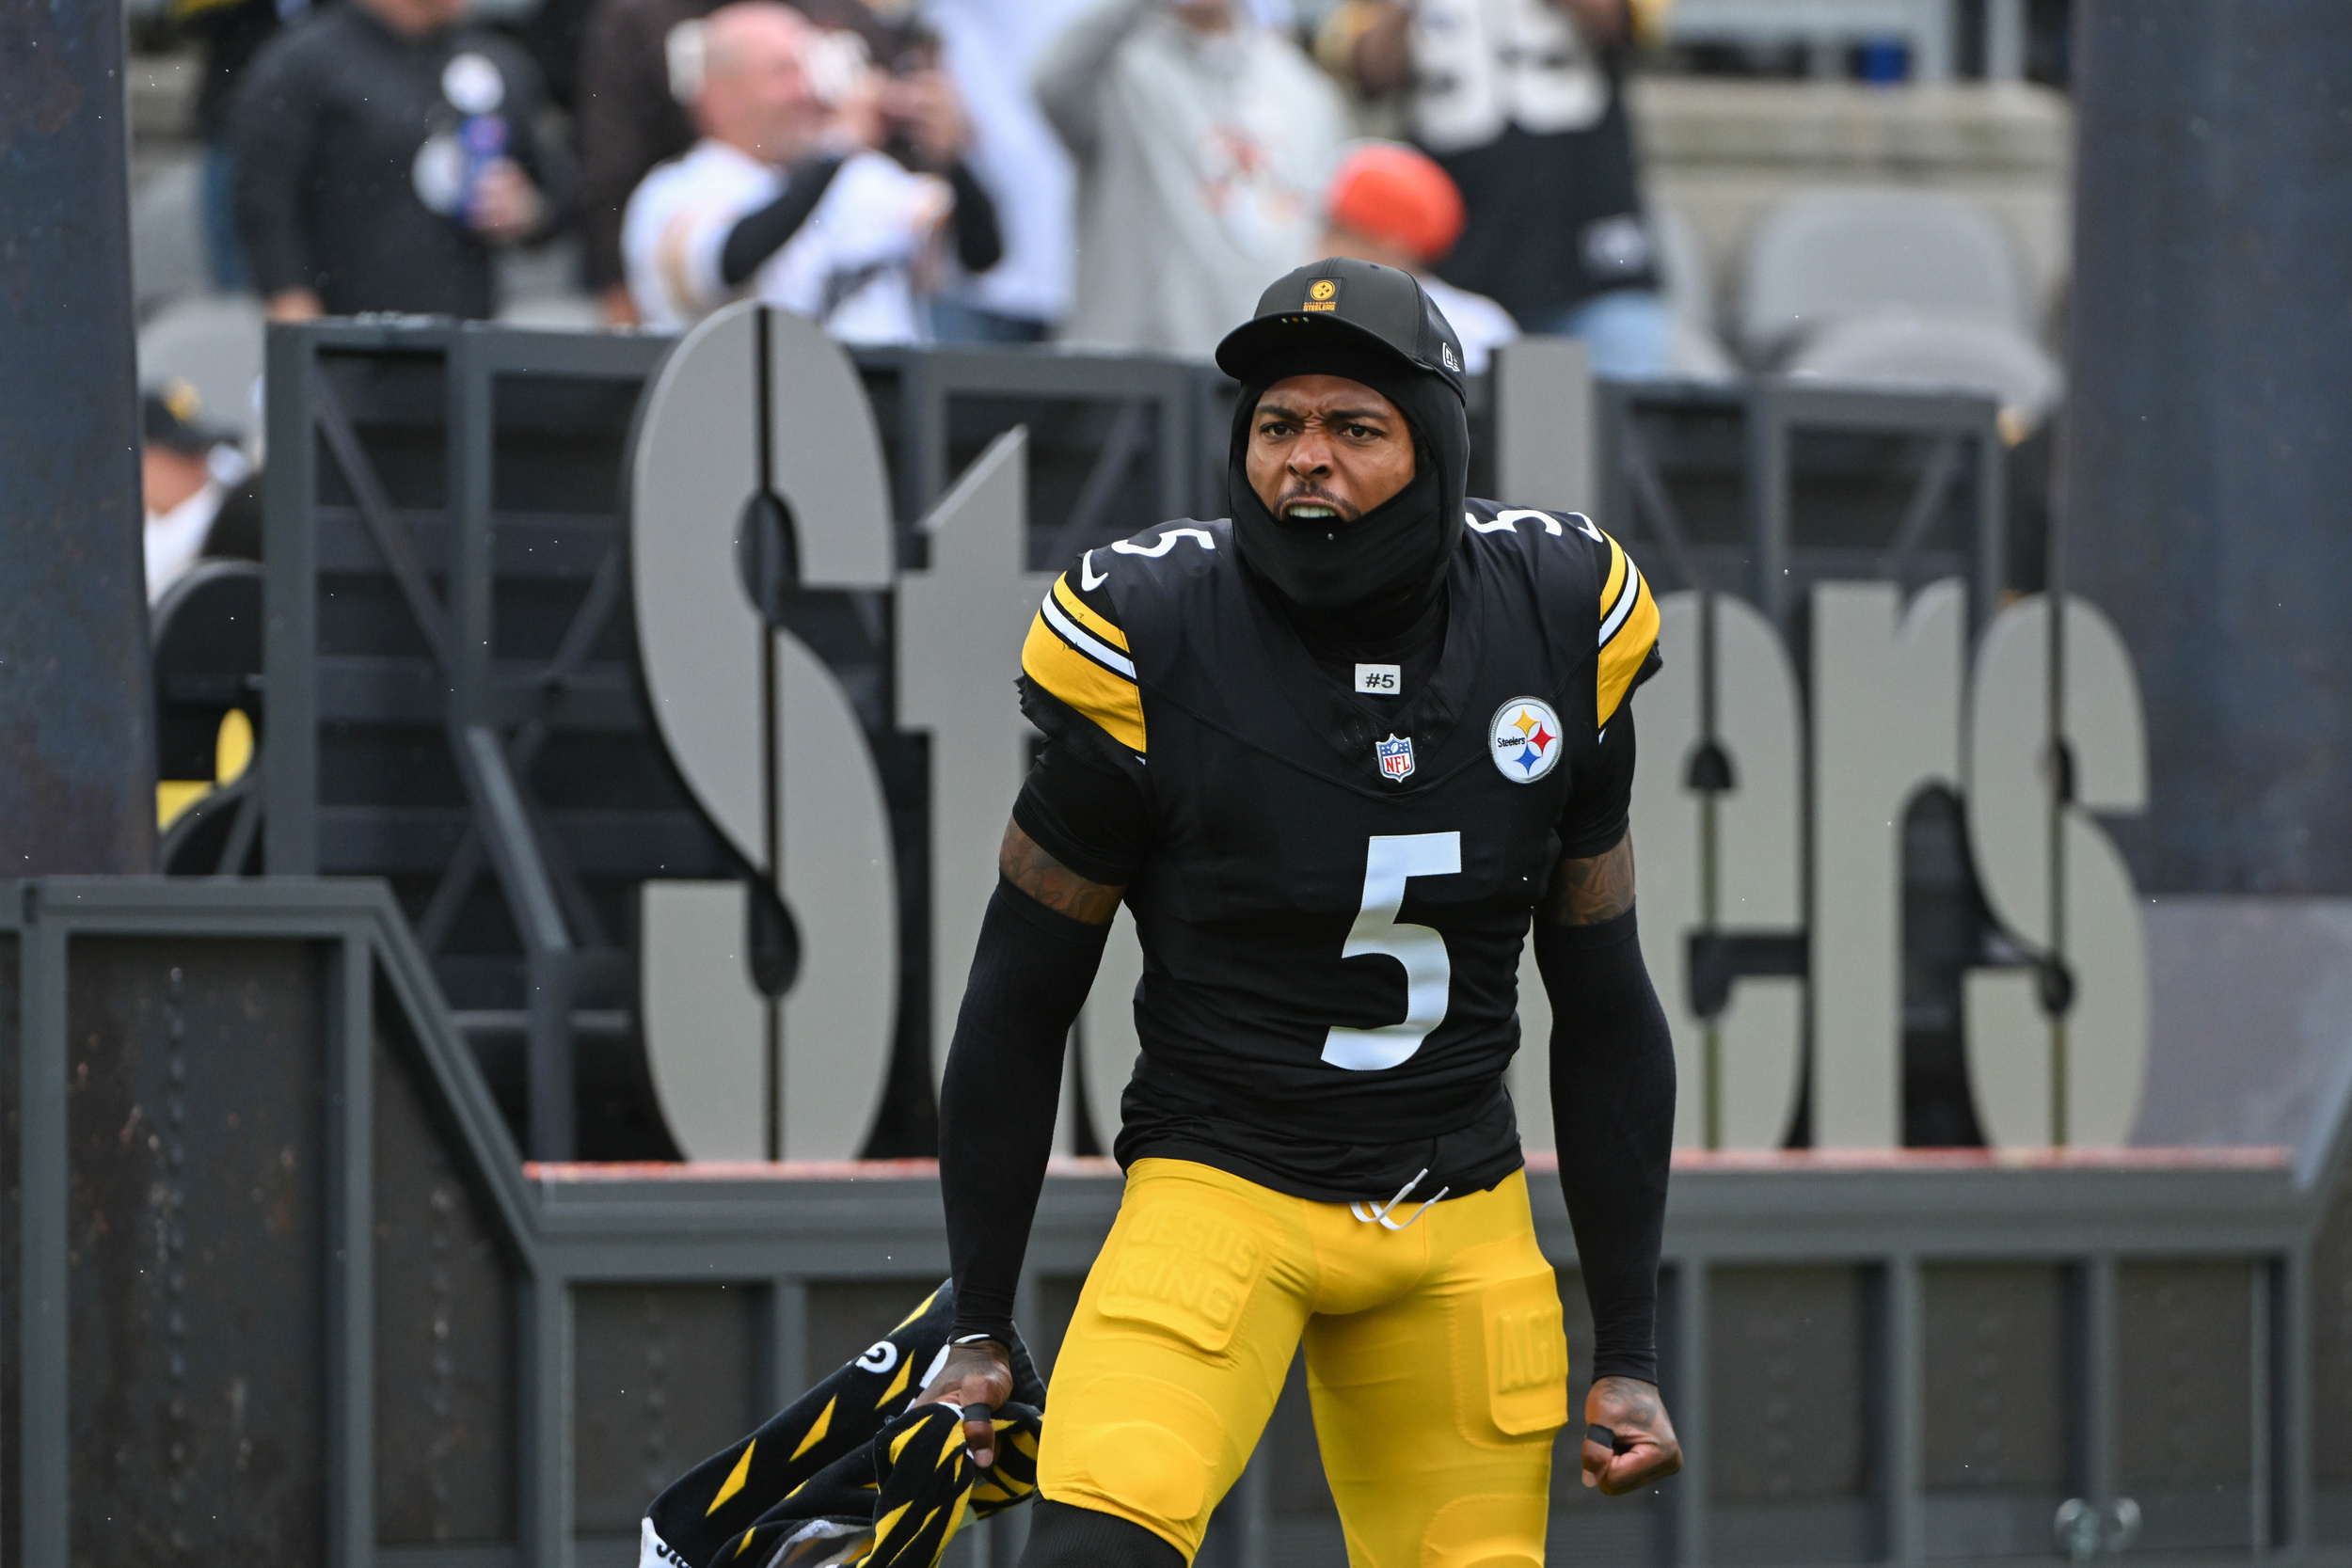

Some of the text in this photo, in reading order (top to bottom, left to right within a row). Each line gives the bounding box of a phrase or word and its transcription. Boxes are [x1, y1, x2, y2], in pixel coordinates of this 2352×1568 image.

[1365, 673, 1395, 689] #5
[1497, 736, 1526, 748] Steelers
[1384, 756, 1410, 774] NFL
[1320, 831, 1462, 1071] 5
[1129, 1210, 1259, 1283] JESUS
[1108, 1257, 1238, 1329] KING
